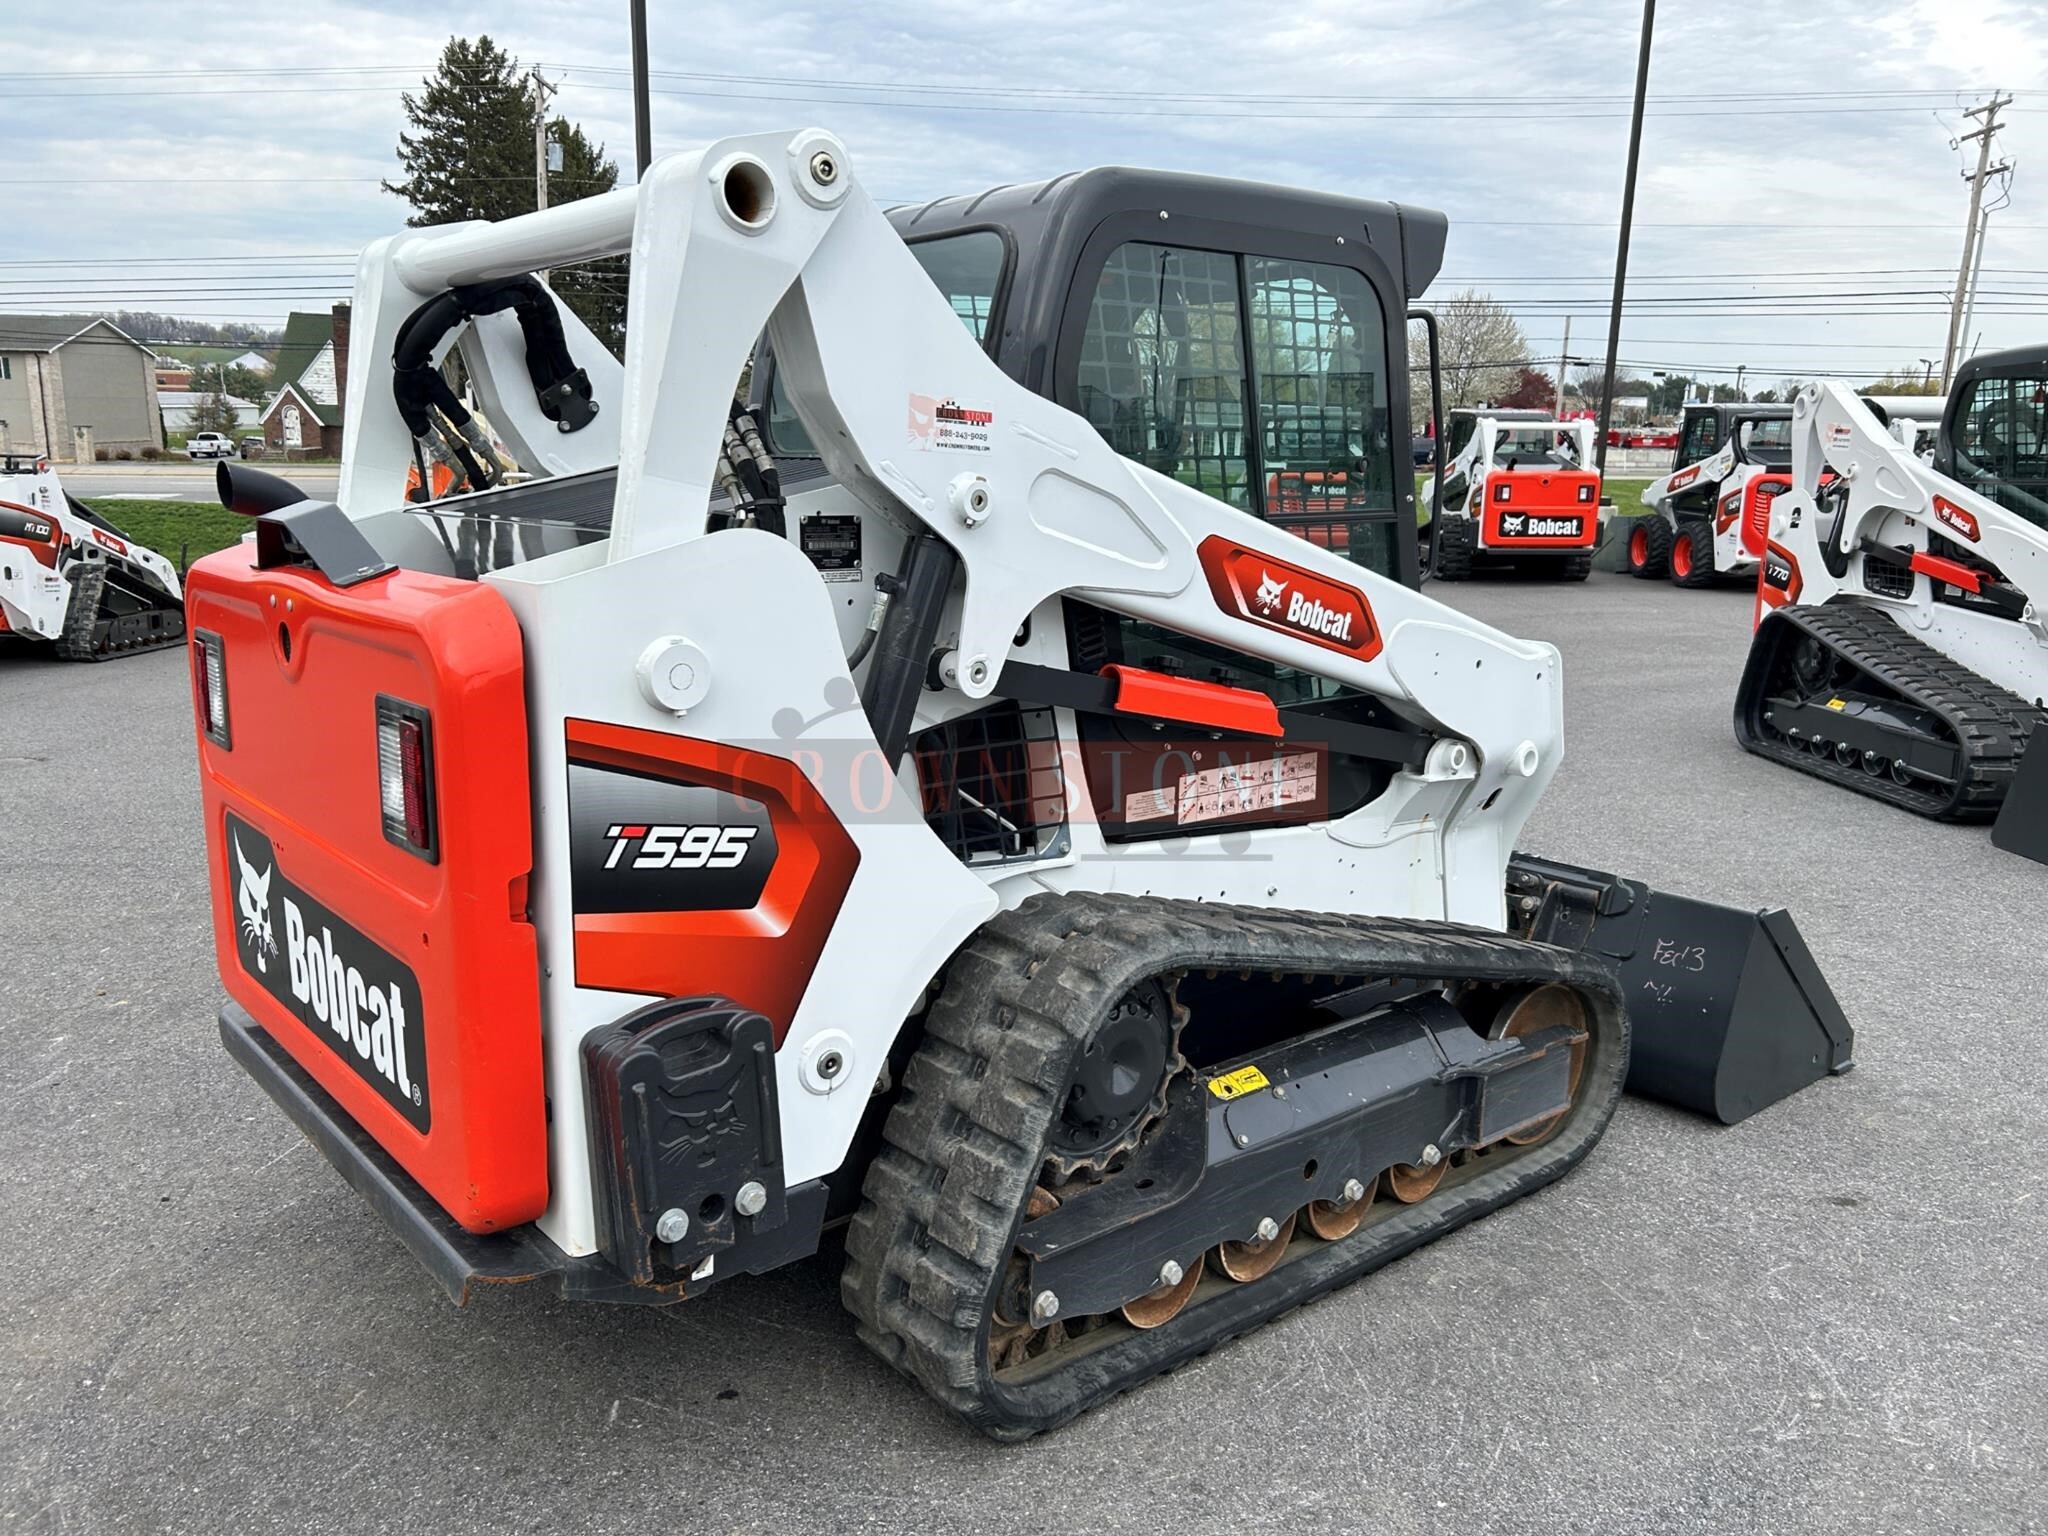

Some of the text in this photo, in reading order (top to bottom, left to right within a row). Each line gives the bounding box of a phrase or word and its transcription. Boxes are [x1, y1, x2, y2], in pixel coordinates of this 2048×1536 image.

[1528, 518, 1578, 535] Bobcat
[1950, 513, 1972, 535] Bobcat
[1286, 591, 1353, 642] Bobcat
[603, 824, 759, 870] T595
[283, 896, 411, 1099] Bobcat
